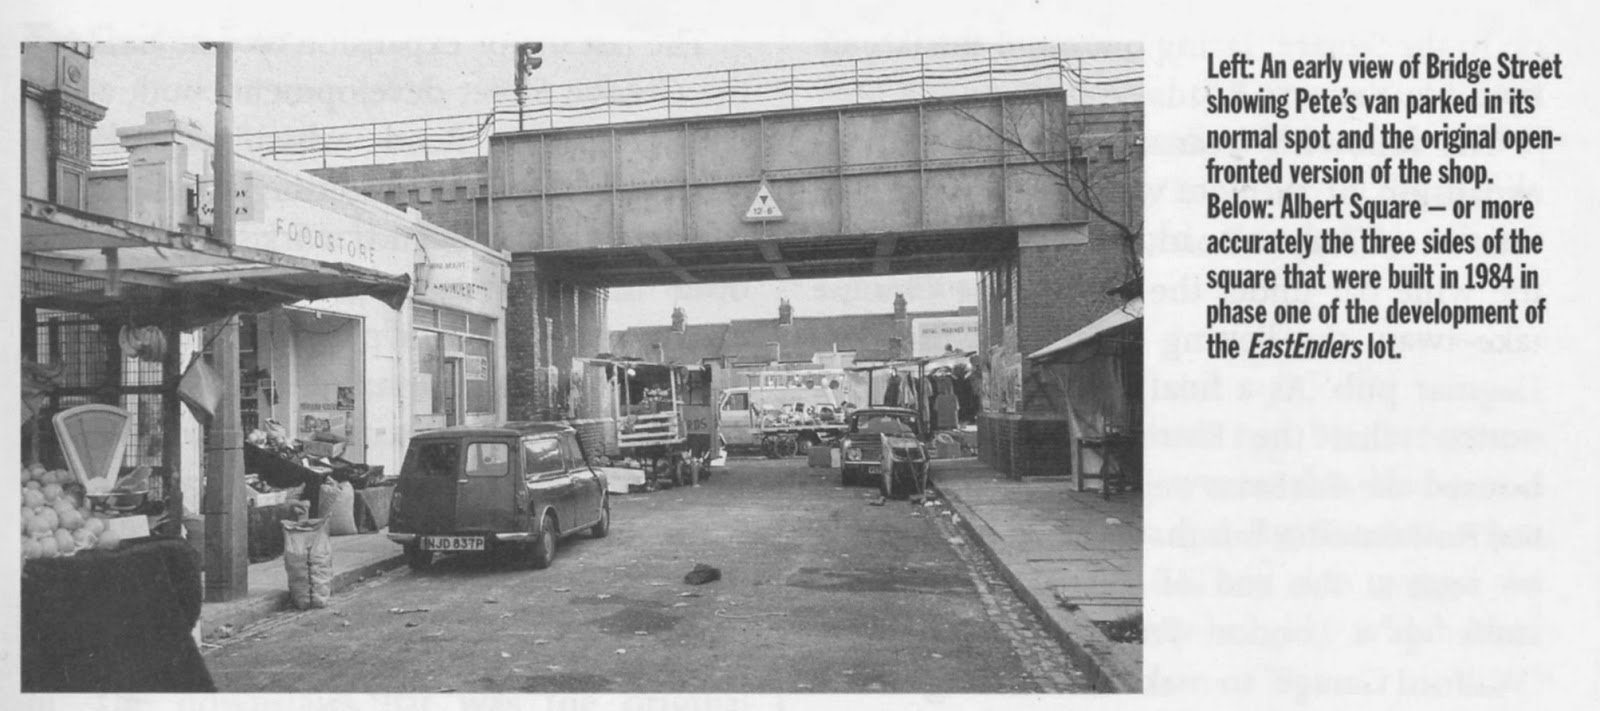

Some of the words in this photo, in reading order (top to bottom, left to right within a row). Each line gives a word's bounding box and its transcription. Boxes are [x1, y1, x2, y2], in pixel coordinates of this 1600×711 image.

[1208, 52, 1254, 78] Left:
[1261, 53, 1286, 78] An
[1293, 53, 1342, 83] early
[1349, 53, 1393, 78] view
[1400, 53, 1421, 79] of
[1427, 53, 1491, 84] Bridge
[1498, 52, 1562, 79] Street
[1207, 88, 1289, 119] showing
[1364, 95, 1399, 114] van
[1407, 88, 1477, 119] parked
[1485, 88, 1502, 114] in
[1510, 88, 1535, 114] its
[1207, 123, 1277, 149] normal
[1285, 124, 1330, 154] spot
[1337, 123, 1374, 149] and
[1381, 123, 1414, 149] the
[1421, 123, 1496, 154] original
[1503, 130, 1561, 154] open-
[1206, 158, 1282, 184] fronted
[1290, 158, 1363, 184] version
[1371, 158, 1392, 184] of
[1398, 158, 1431, 184] the
[1439, 158, 1493, 189] shop.
[1208, 193, 1273, 219] Below:
[1281, 193, 1343, 219] Albert
[1350, 192, 1421, 224] Square
[1453, 200, 1475, 219] or
[1482, 200, 1534, 219] more
[276, 217, 376, 264] FOODSTORE
[1207, 228, 1313, 259] accurately
[1320, 228, 1354, 254] the
[1361, 228, 1415, 254] three
[1423, 228, 1475, 254] sides
[1482, 228, 1503, 254] of
[1509, 228, 1543, 254] the
[1207, 270, 1276, 294] square
[1283, 263, 1326, 289] that
[1332, 270, 1381, 289] were
[1389, 263, 1434, 289] built
[1441, 263, 1458, 289] in
[1465, 263, 1514, 289] 1984
[1521, 263, 1538, 289] in
[1207, 298, 1267, 329] phase
[1274, 305, 1311, 324] one
[1318, 298, 1339, 324] of
[1345, 298, 1379, 324] the
[1387, 298, 1518, 329] development
[1525, 298, 1546, 324] of
[1206, 333, 1240, 358] the
[1248, 333, 1363, 359] EastEnders
[1368, 333, 1401, 359] lot.
[453, 537, 483, 549] 837P
